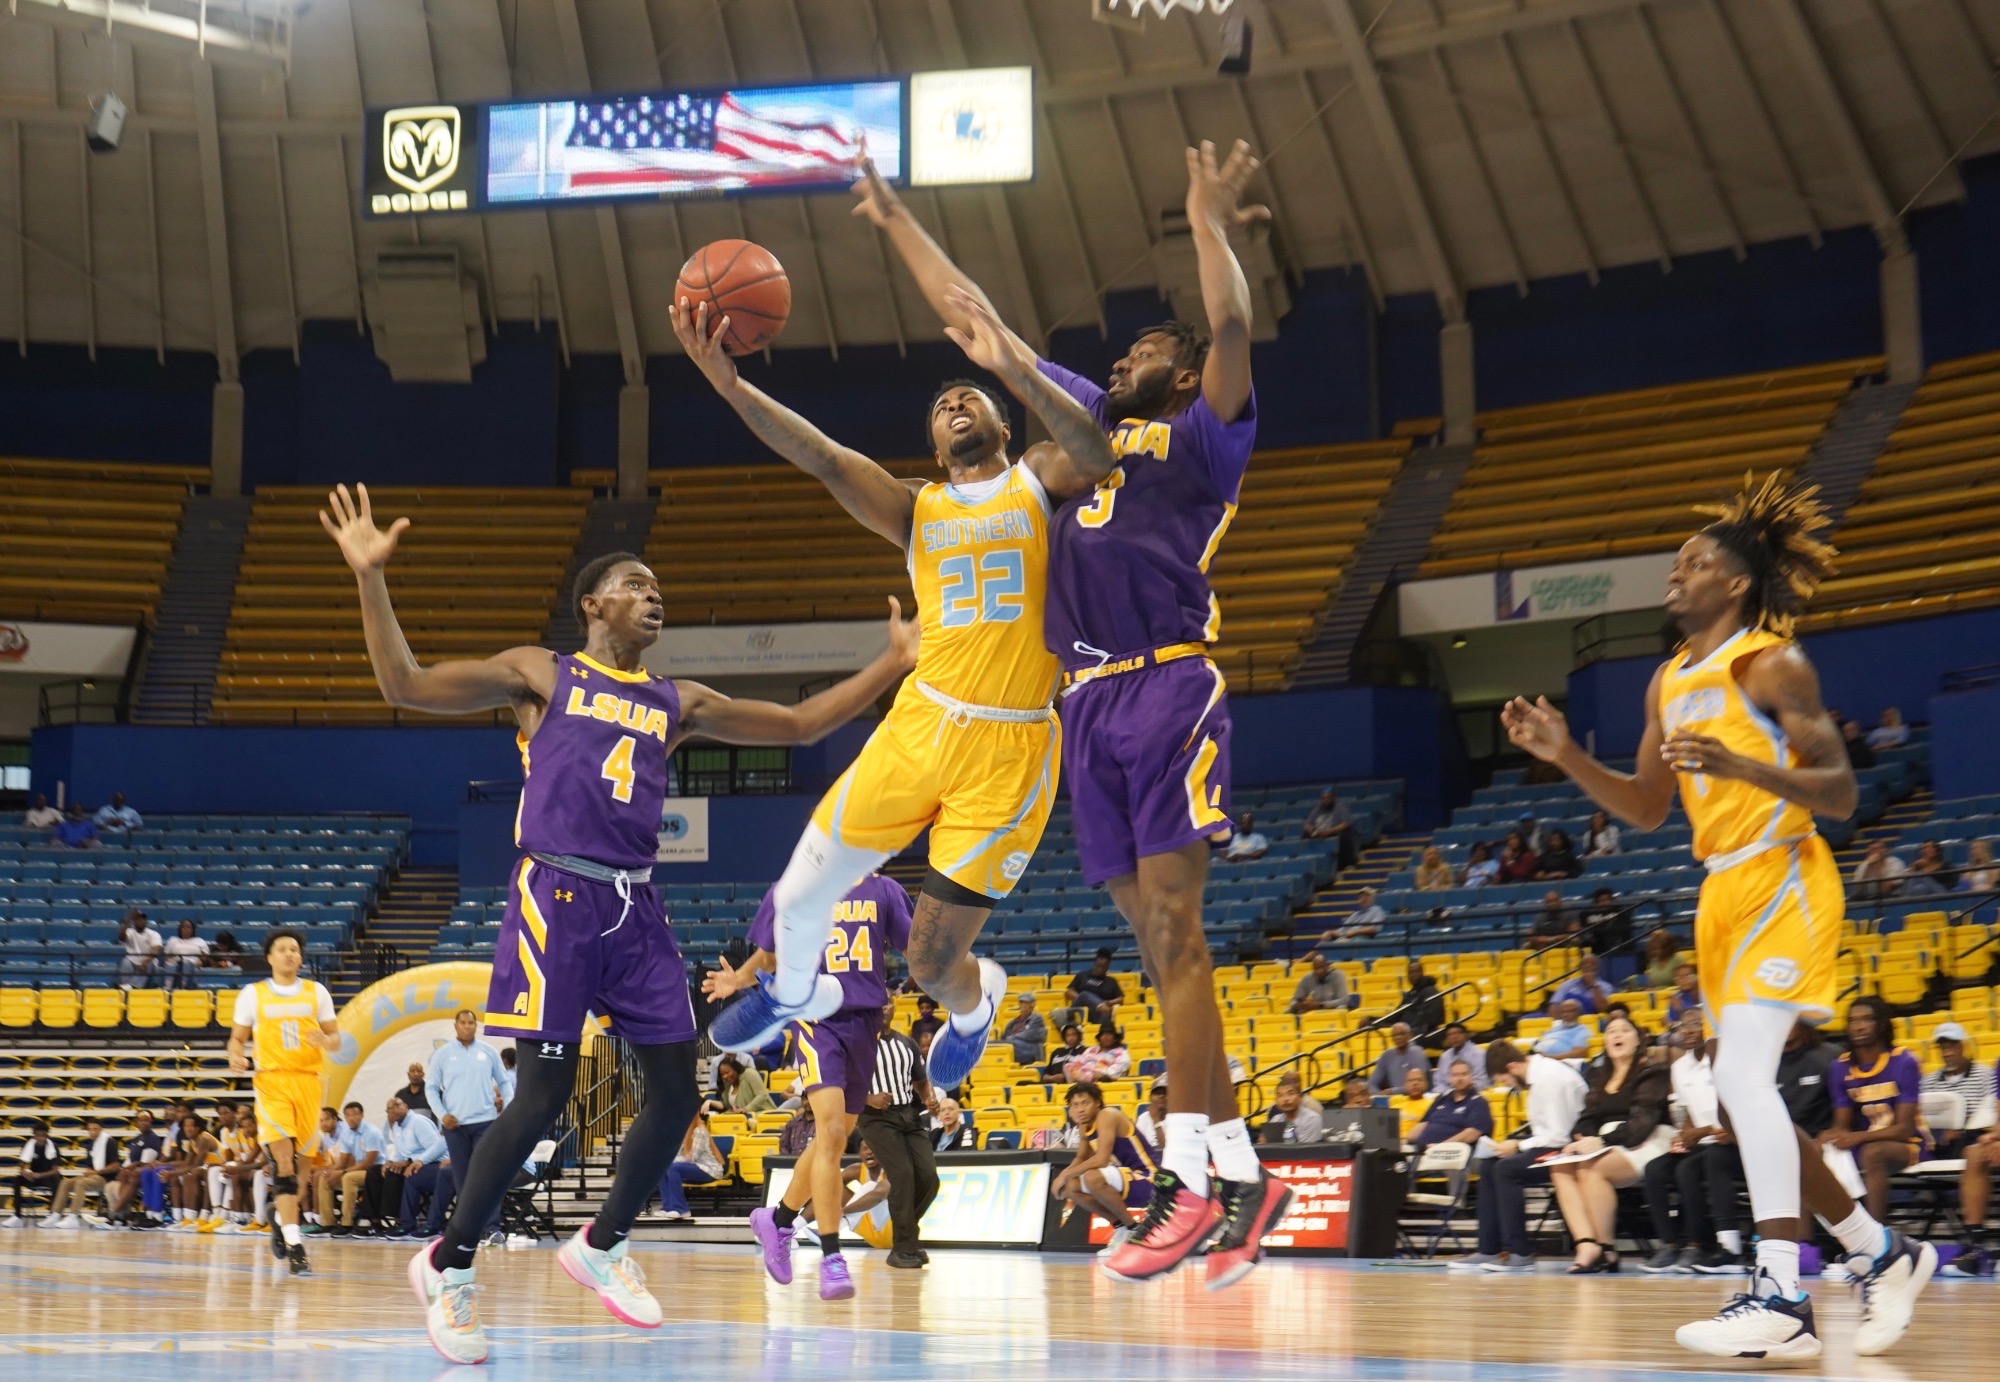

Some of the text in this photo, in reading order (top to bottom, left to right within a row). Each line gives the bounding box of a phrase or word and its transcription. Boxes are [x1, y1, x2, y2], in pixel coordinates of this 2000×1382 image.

[922, 508, 1034, 554] SOUTHERN
[938, 548, 1026, 629] 22
[565, 686, 668, 744] LSUA
[601, 735, 637, 804] 4
[832, 899, 878, 924] SUA
[824, 926, 873, 974] 24
[371, 978, 462, 1033] ALL
